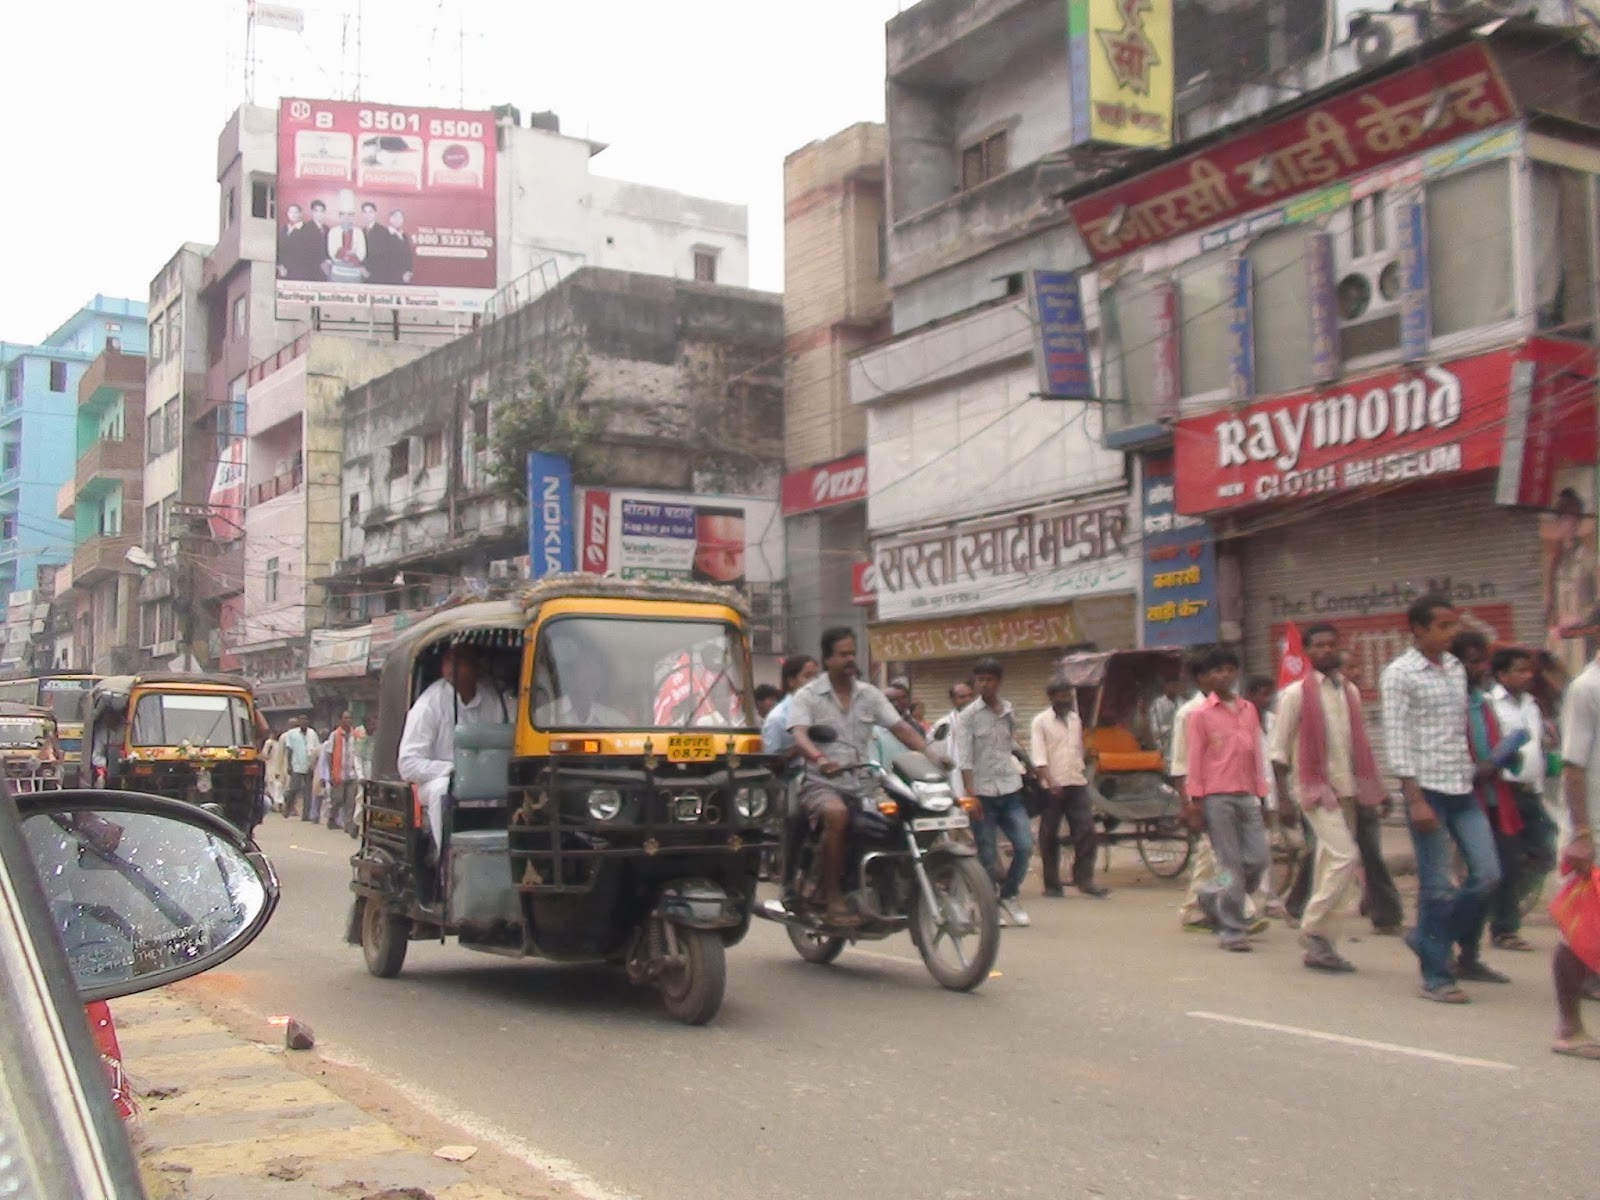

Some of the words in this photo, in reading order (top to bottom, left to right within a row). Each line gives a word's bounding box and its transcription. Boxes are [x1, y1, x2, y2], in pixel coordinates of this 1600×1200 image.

[359, 109, 420, 132] 3501
[429, 120, 483, 138] 5500
[1214, 365, 1463, 471] Raymond
[1253, 467, 1337, 501] CLOTH
[1343, 444, 1463, 488] MUSEUM
[543, 476, 562, 575] NOKIA
[138, 948, 164, 962] THEY
